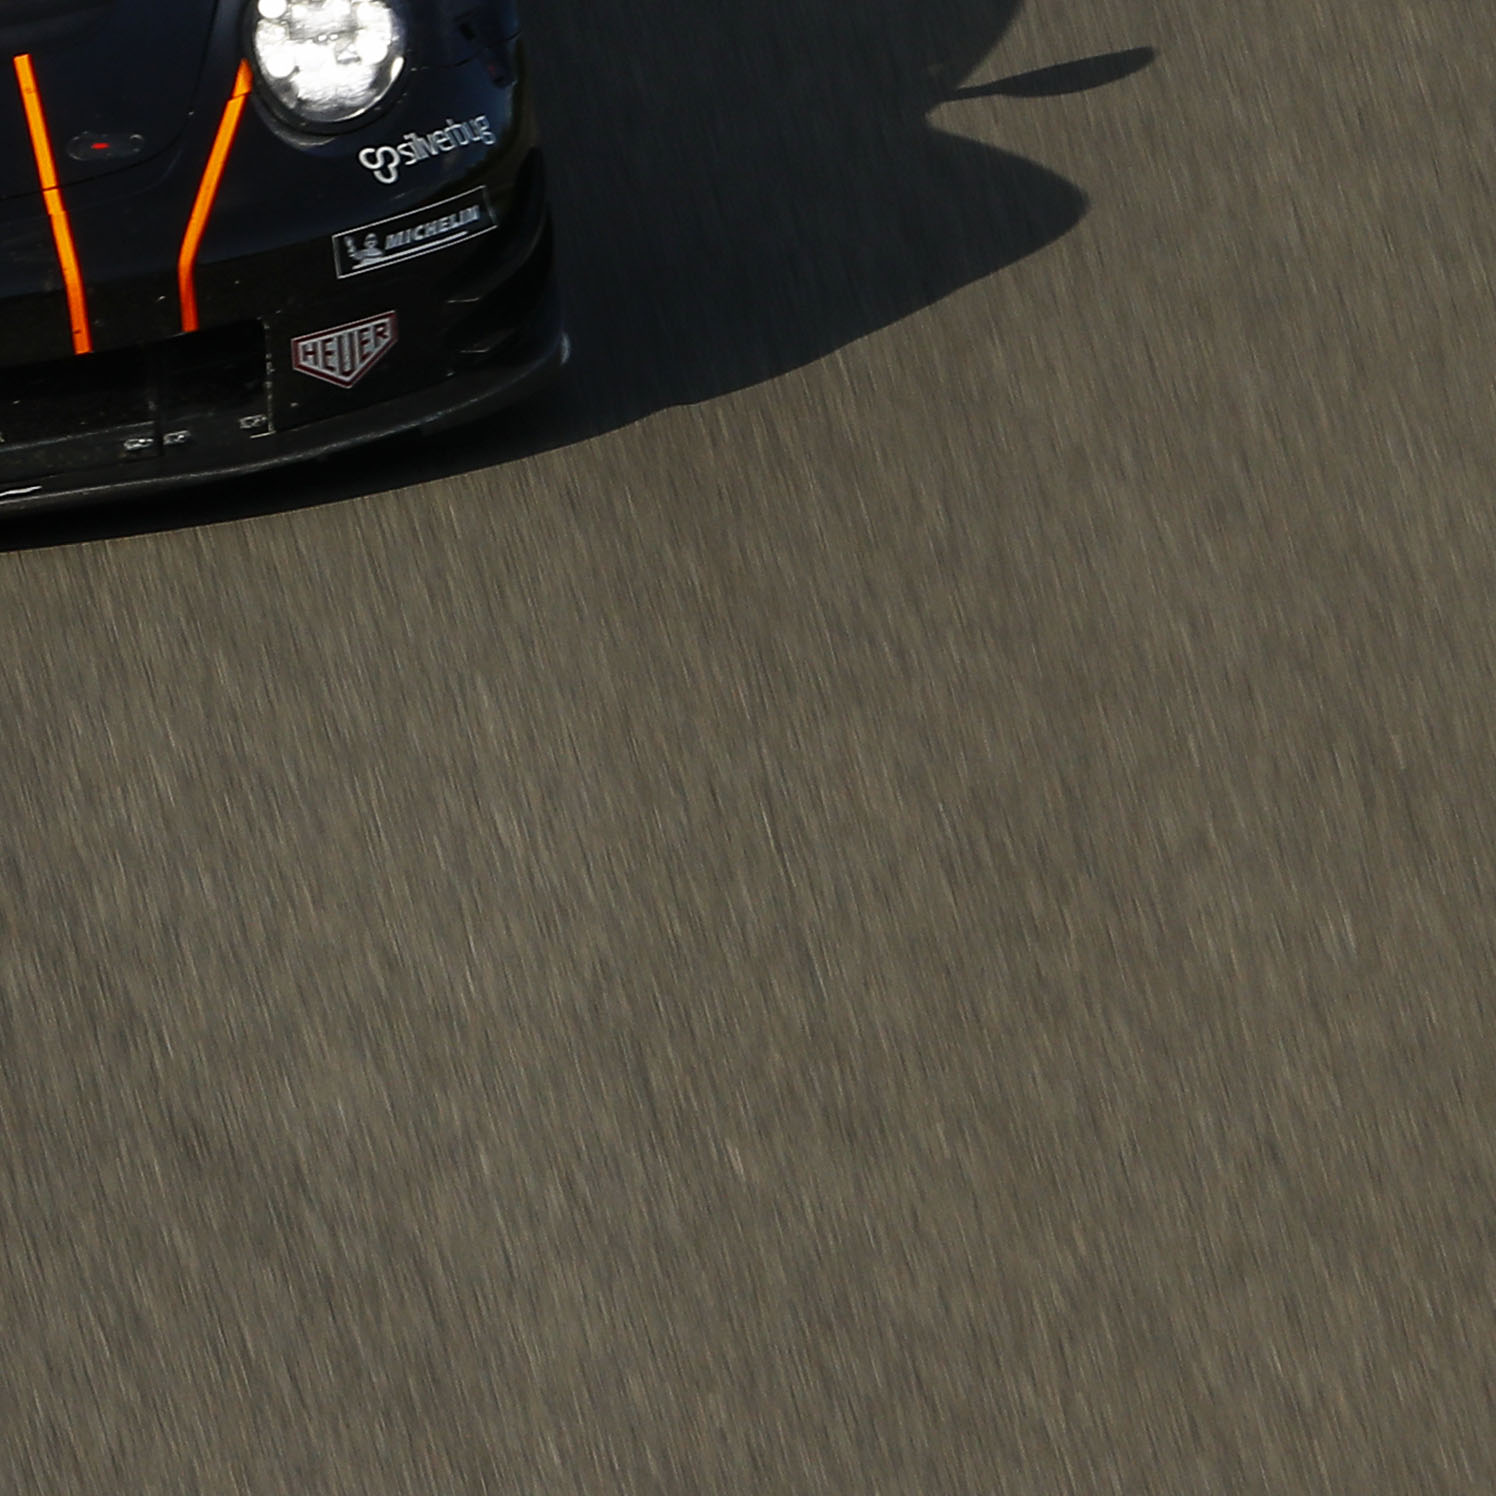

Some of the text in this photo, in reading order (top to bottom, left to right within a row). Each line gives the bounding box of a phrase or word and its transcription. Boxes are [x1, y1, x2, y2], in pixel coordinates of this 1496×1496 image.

[397, 115, 495, 166] silverbug
[384, 205, 480, 250] MICHELIN
[302, 321, 390, 378] HEUER
